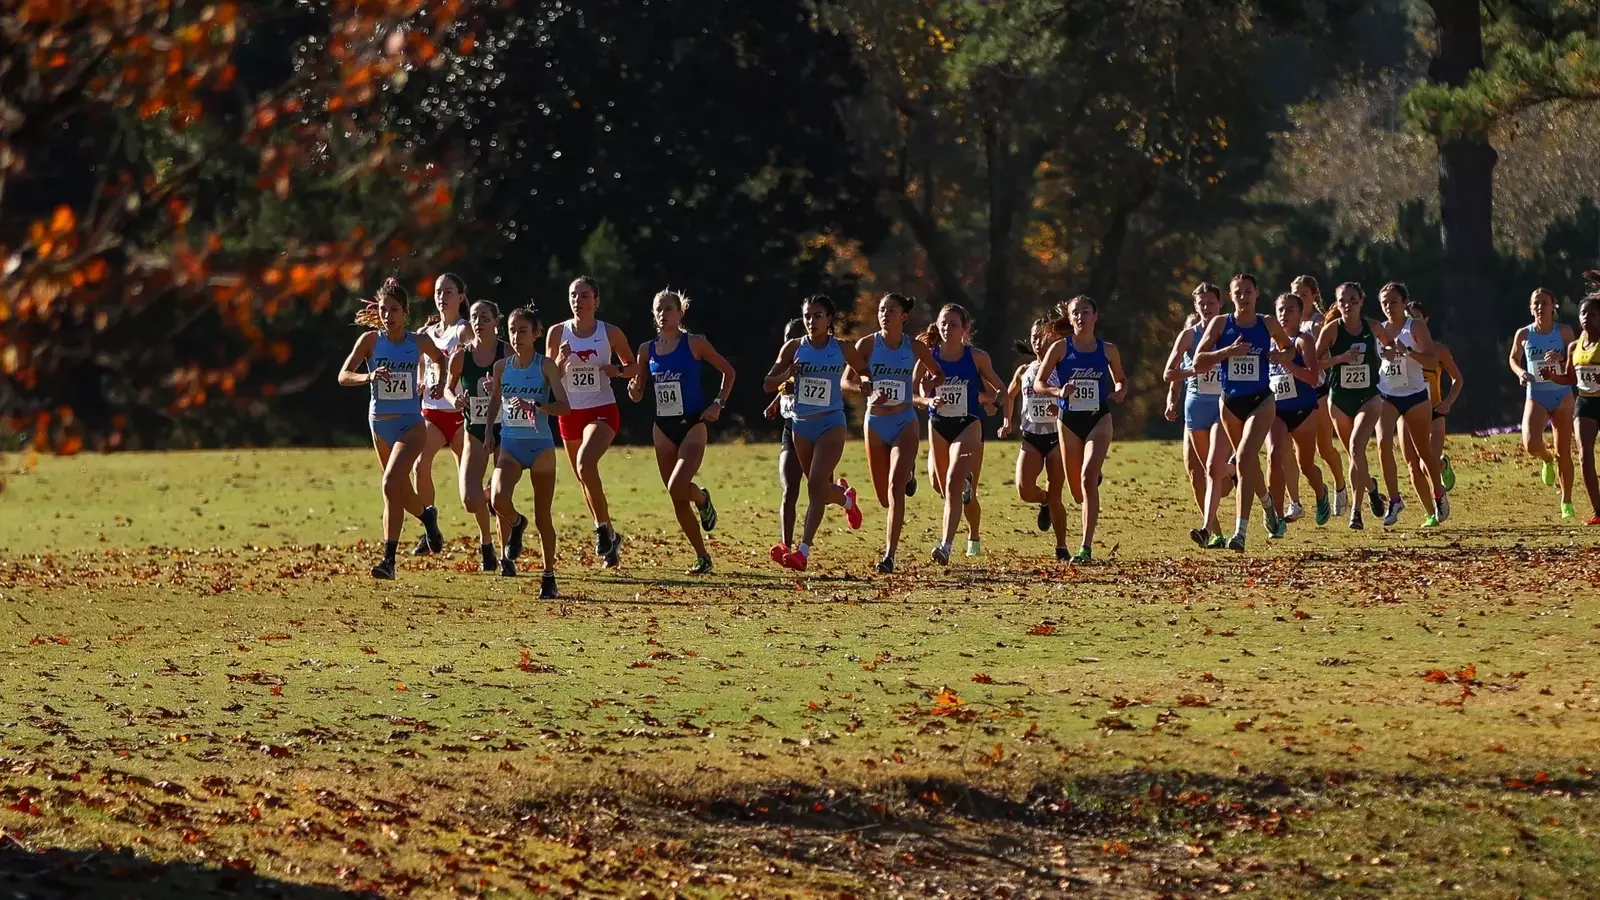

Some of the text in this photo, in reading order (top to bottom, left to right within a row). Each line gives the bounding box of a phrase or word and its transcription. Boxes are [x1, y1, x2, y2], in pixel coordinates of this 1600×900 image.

[1070, 367, 1104, 379] Tulsa
[1233, 362, 1254, 375] 399
[1385, 364, 1403, 377] 251
[572, 373, 595, 385] 326
[652, 369, 682, 382] Tulsa
[1345, 372, 1366, 383] 223
[385, 380, 407, 393] 374
[804, 385, 826, 400] 372
[1074, 387, 1095, 399] 395
[657, 390, 676, 403] 394
[941, 392, 962, 405] 397
